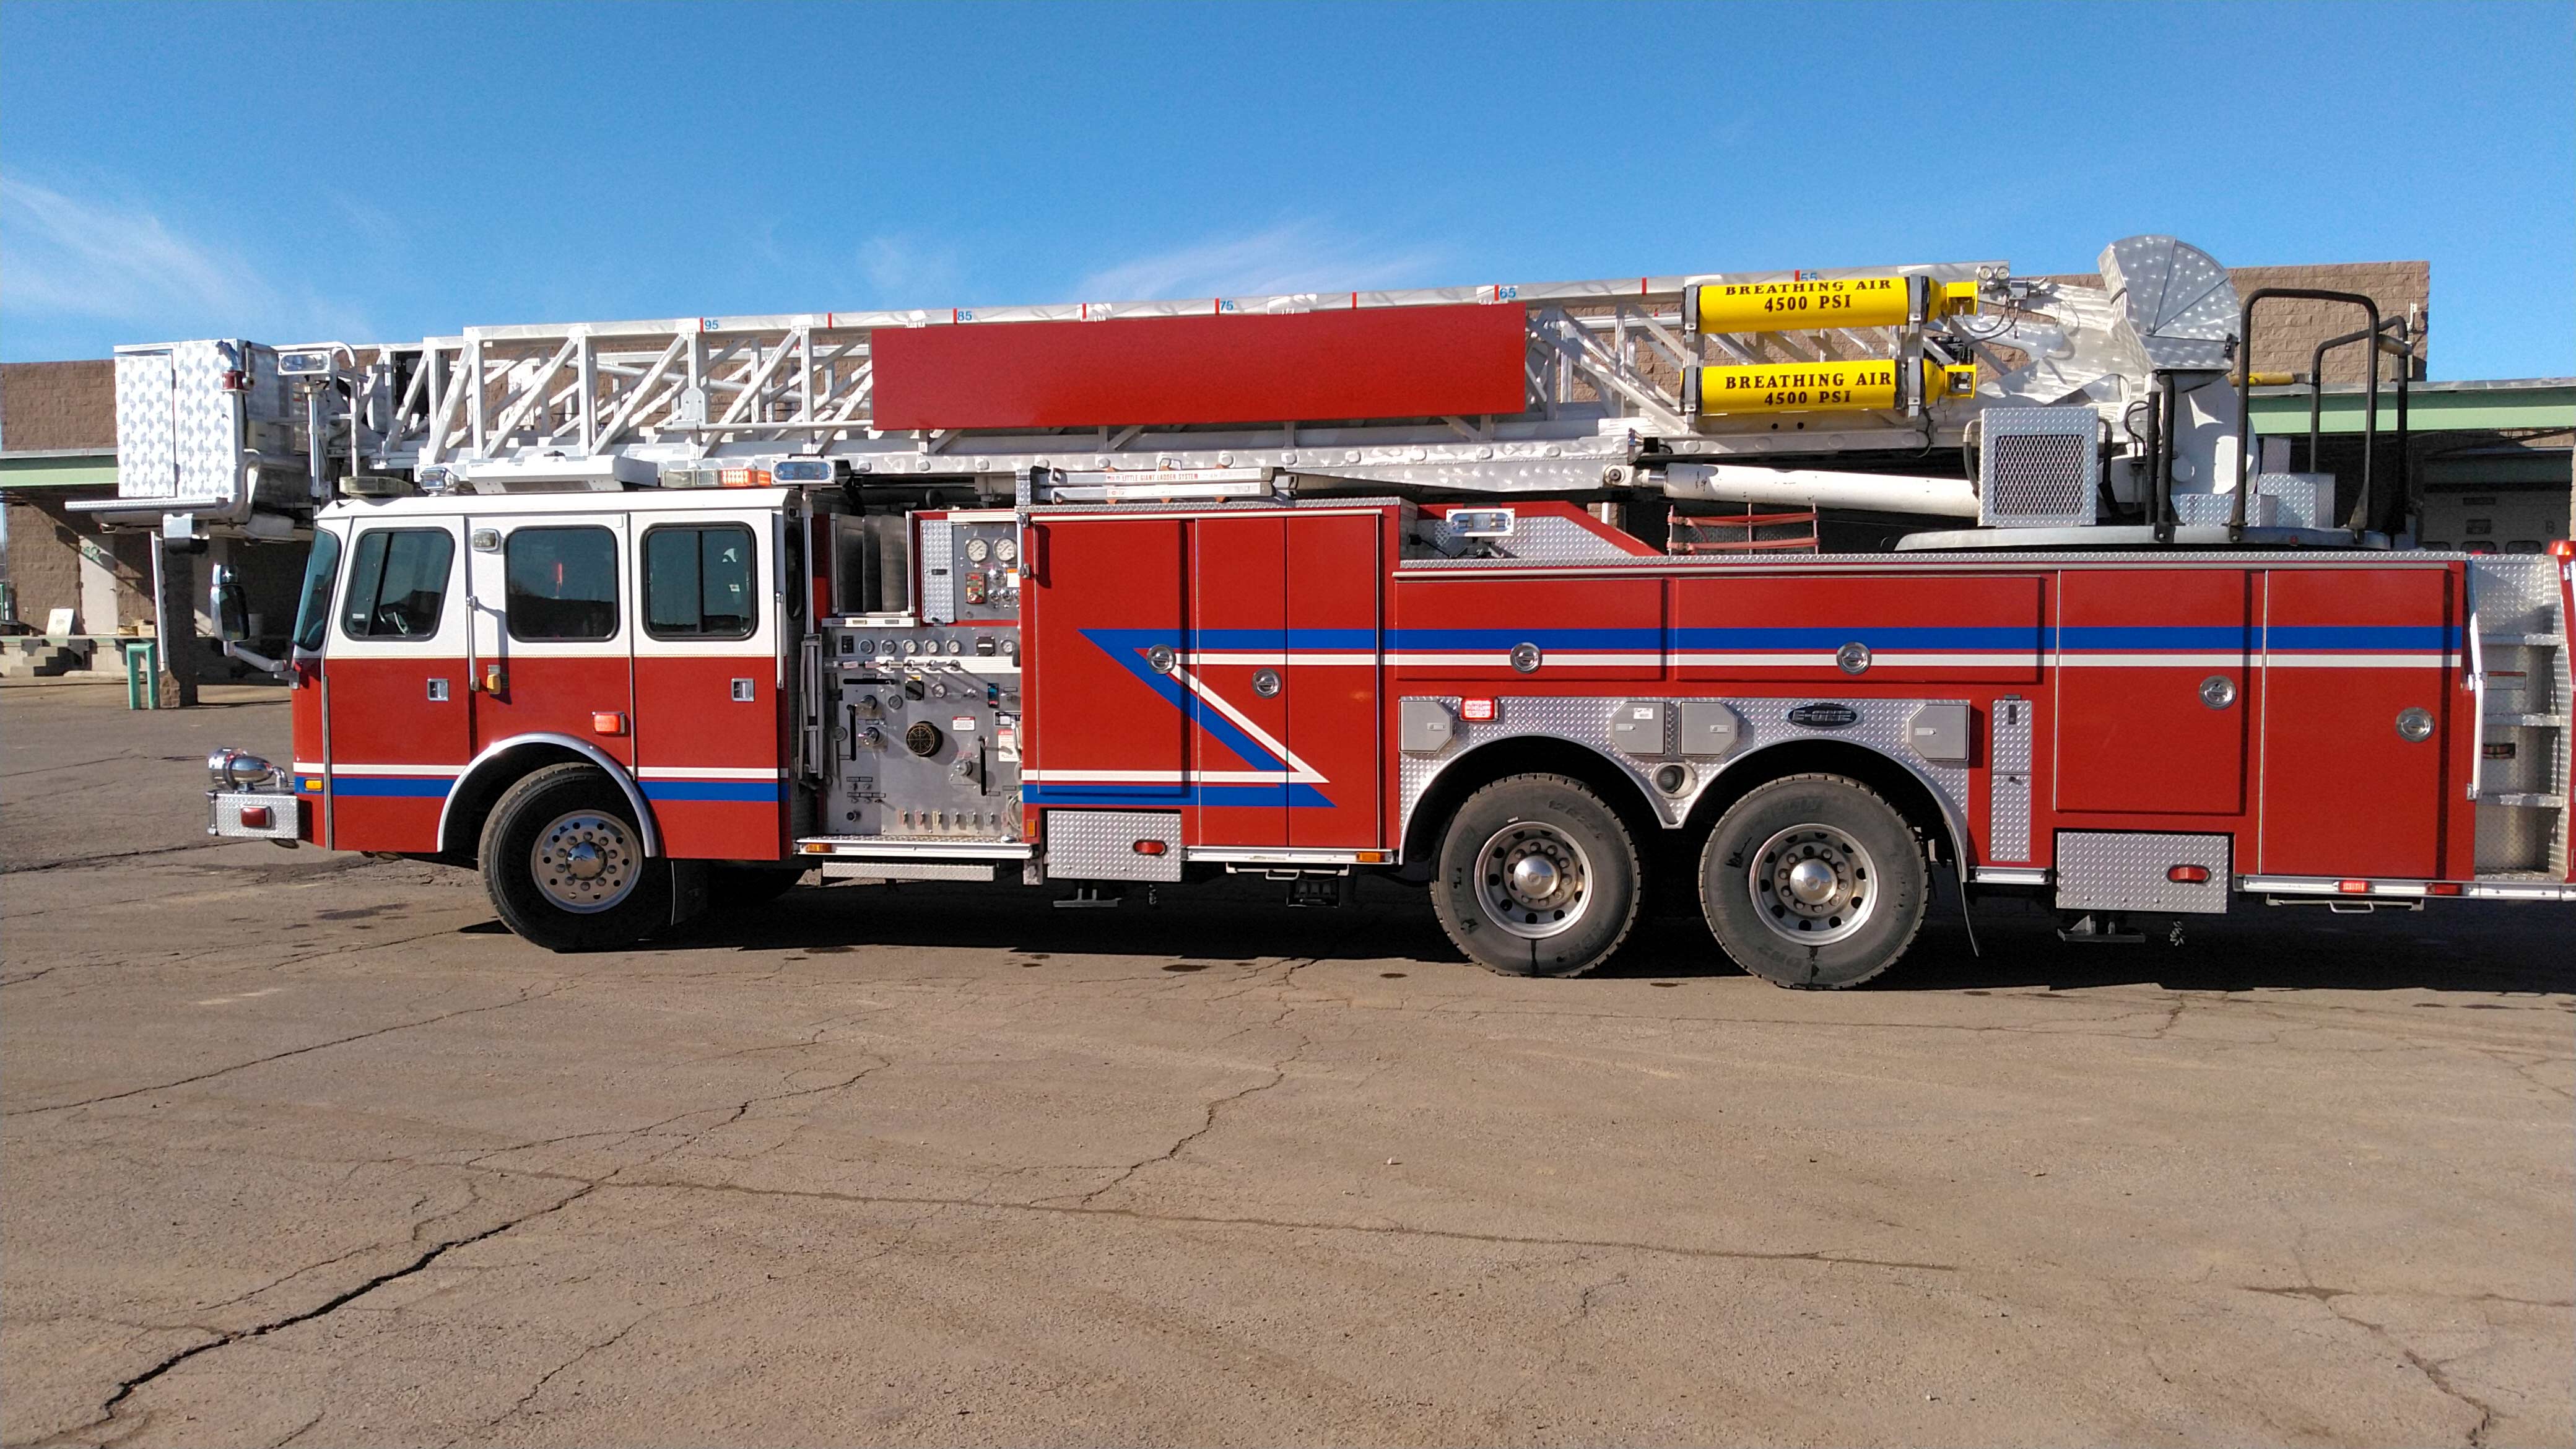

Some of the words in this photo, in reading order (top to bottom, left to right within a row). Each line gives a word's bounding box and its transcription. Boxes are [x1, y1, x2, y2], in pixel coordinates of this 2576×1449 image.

[1500, 287, 1516, 299] 65
[1725, 281, 1844, 295] BREATHING
[1855, 280, 1892, 290] AIR
[1220, 300, 1234, 311] 75
[1764, 296, 1808, 312] 4500
[1819, 294, 1851, 309] PSI
[957, 311, 972, 321] 85
[705, 320, 719, 330] 95
[1725, 373, 1844, 389] BREATHING
[1855, 372, 1892, 386] AIR
[1764, 391, 1808, 406] 4500
[1819, 390, 1851, 403] PSI
[1792, 710, 1852, 721] E-ONE
